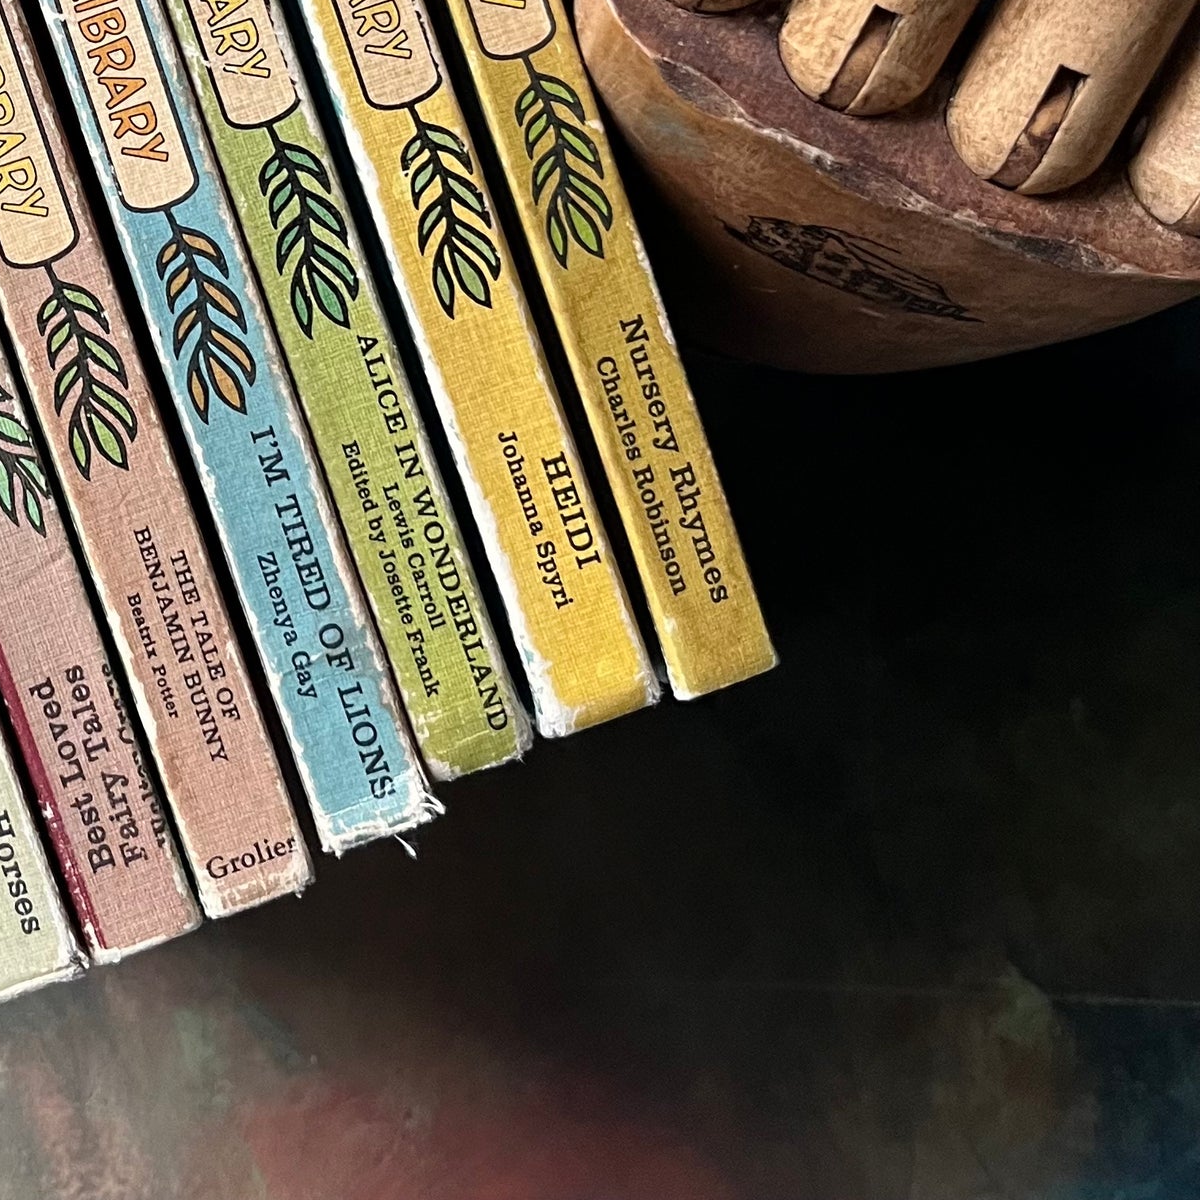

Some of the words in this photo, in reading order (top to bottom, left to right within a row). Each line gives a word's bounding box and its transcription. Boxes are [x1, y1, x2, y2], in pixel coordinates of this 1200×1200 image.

[355, 332, 408, 434] ALICE
[394, 440, 425, 480] IN
[411, 486, 509, 732] WONDERLAND
[497, 430, 545, 537] Johanna
[533, 540, 574, 611] Spyri
[540, 451, 602, 570] HEIDI
[596, 355, 643, 461] Charles
[631, 464, 688, 597] Robinson
[617, 314, 682, 455] Nursery
[666, 461, 731, 605] Rhymes
[249, 425, 290, 487] I'M
[274, 493, 332, 612] TIRED
[317, 622, 355, 674] OF
[336, 681, 396, 800] LIONS
[255, 551, 300, 647] Zhenya
[289, 650, 319, 700] Gay
[340, 440, 379, 513] Edited
[366, 515, 388, 544] by
[377, 548, 415, 626] Josette
[405, 628, 441, 698] Frank
[381, 482, 416, 549] Lewis
[406, 552, 446, 631] Carroll
[126, 592, 158, 659] Beatrix
[150, 663, 180, 720] Potter
[133, 525, 194, 665] BENJAMIN
[182, 670, 229, 763] BUNNY
[169, 549, 201, 606] THE
[189, 610, 226, 680] TALE
[215, 686, 241, 722] OF
[28, 676, 86, 789] Loved
[62, 664, 111, 763] Tales
[69, 792, 116, 875] Best
[98, 769, 151, 868] Fairy
[205, 834, 297, 880] Grolier
